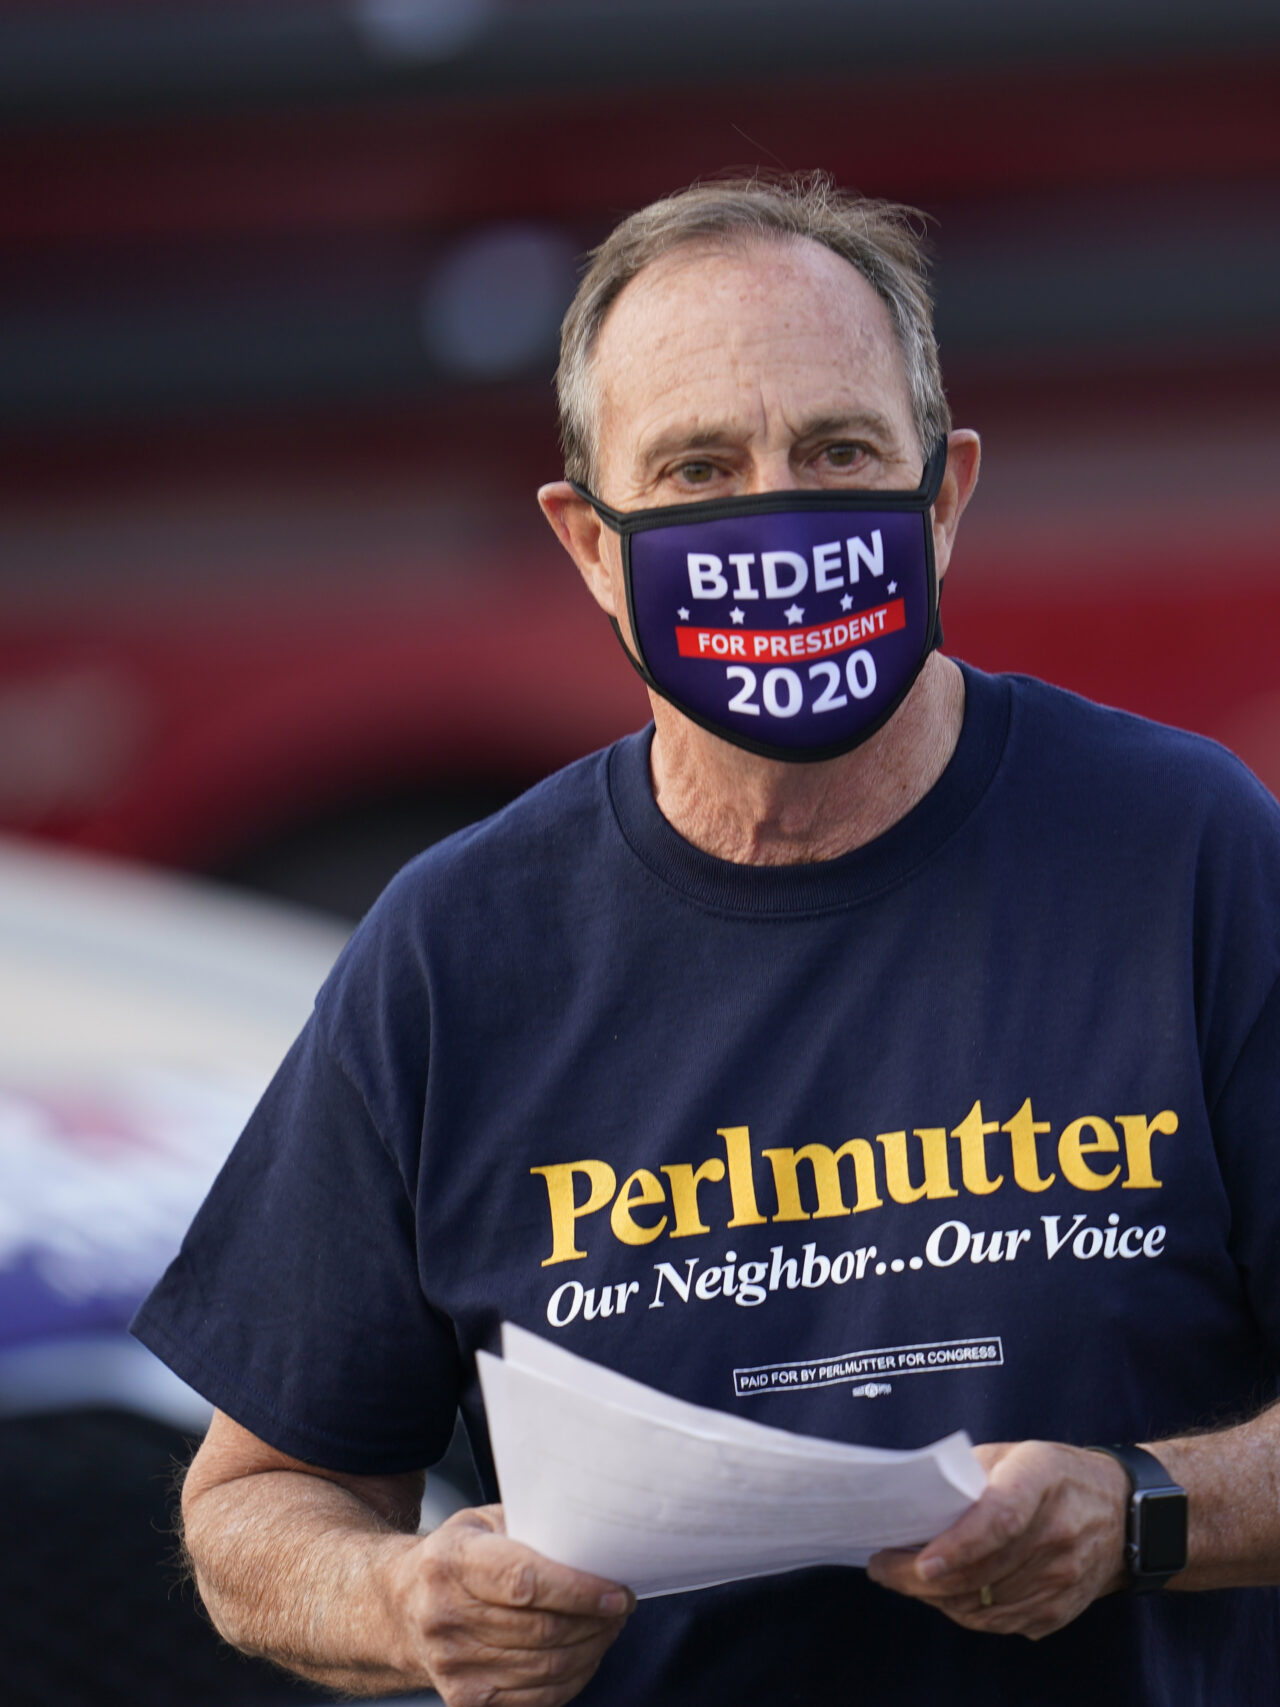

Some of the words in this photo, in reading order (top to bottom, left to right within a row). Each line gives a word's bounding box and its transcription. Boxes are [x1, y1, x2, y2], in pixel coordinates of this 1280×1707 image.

[687, 529, 885, 600] BIDEN
[698, 632, 747, 656] FOR
[754, 608, 888, 657] PRESIDENT
[726, 649, 878, 719] 2020
[530, 1097, 1179, 1267] Perlmutter
[546, 1279, 639, 1328] Our
[1040, 1212, 1167, 1260] Voice
[740, 1373, 769, 1389] PAID
[772, 1370, 798, 1385] FOR
[801, 1367, 816, 1381] BY
[819, 1355, 896, 1379] PERLMUTTER
[899, 1352, 925, 1366] FOR
[928, 1345, 997, 1363] CONGRESS
